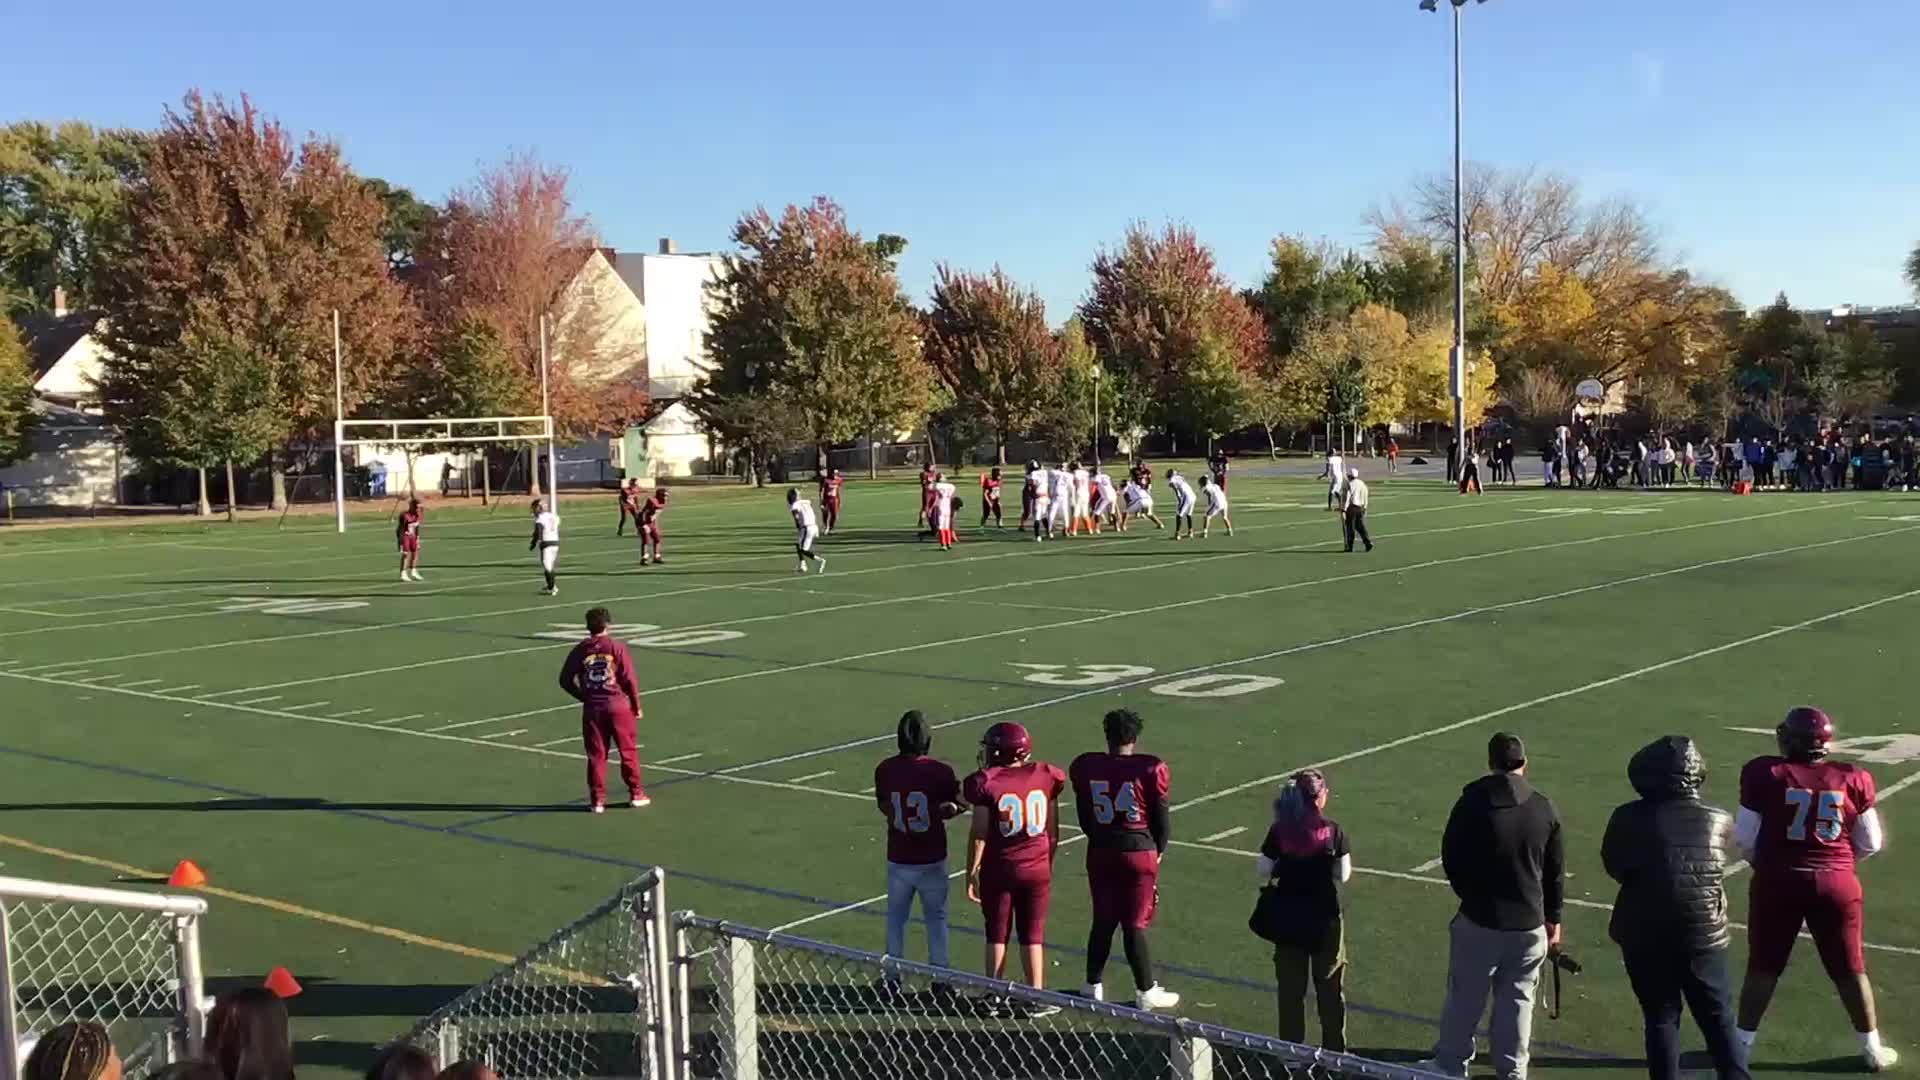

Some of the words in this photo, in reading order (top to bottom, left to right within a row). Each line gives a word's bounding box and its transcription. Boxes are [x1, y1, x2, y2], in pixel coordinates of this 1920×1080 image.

[1023, 664, 1286, 697] 30
[890, 791, 931, 833] 13
[999, 789, 1048, 838] 30
[1089, 780, 1140, 825] 54
[1785, 787, 1844, 843] 75
